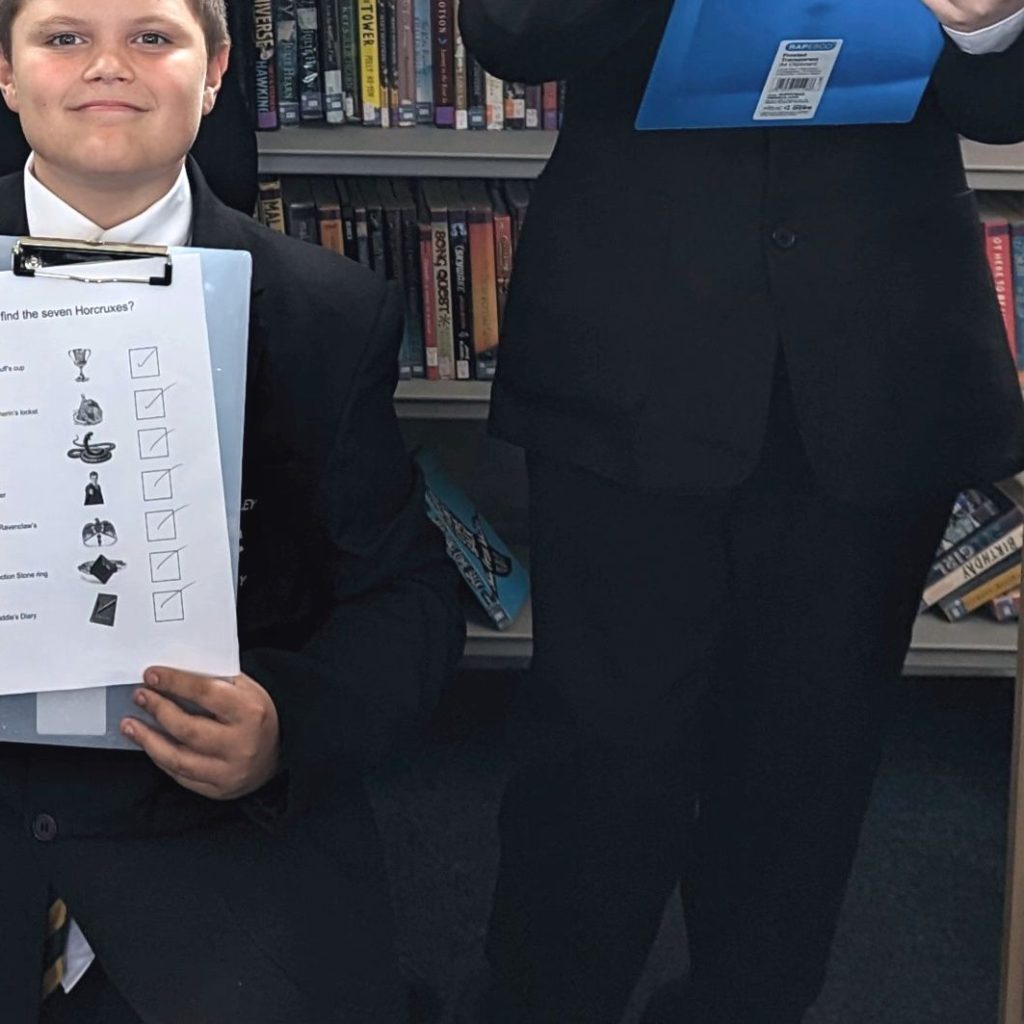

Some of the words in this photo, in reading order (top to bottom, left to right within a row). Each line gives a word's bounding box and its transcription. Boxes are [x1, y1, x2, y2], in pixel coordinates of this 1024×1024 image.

[361, 5, 375, 46] TOWER
[283, 68, 294, 99] HEARN
[0, 309, 20, 321] find
[22, 309, 38, 320] the
[41, 308, 72, 318] seven
[75, 301, 134, 316] Horcruxes?
[12, 364, 25, 372] cup
[0, 522, 38, 530] Ravenclaw's
[933, 544, 975, 577] GIRL
[961, 535, 1016, 579] BIRTHDAY
[16, 571, 35, 579] Stone
[36, 571, 48, 579] ring
[20, 612, 37, 621] Diary
